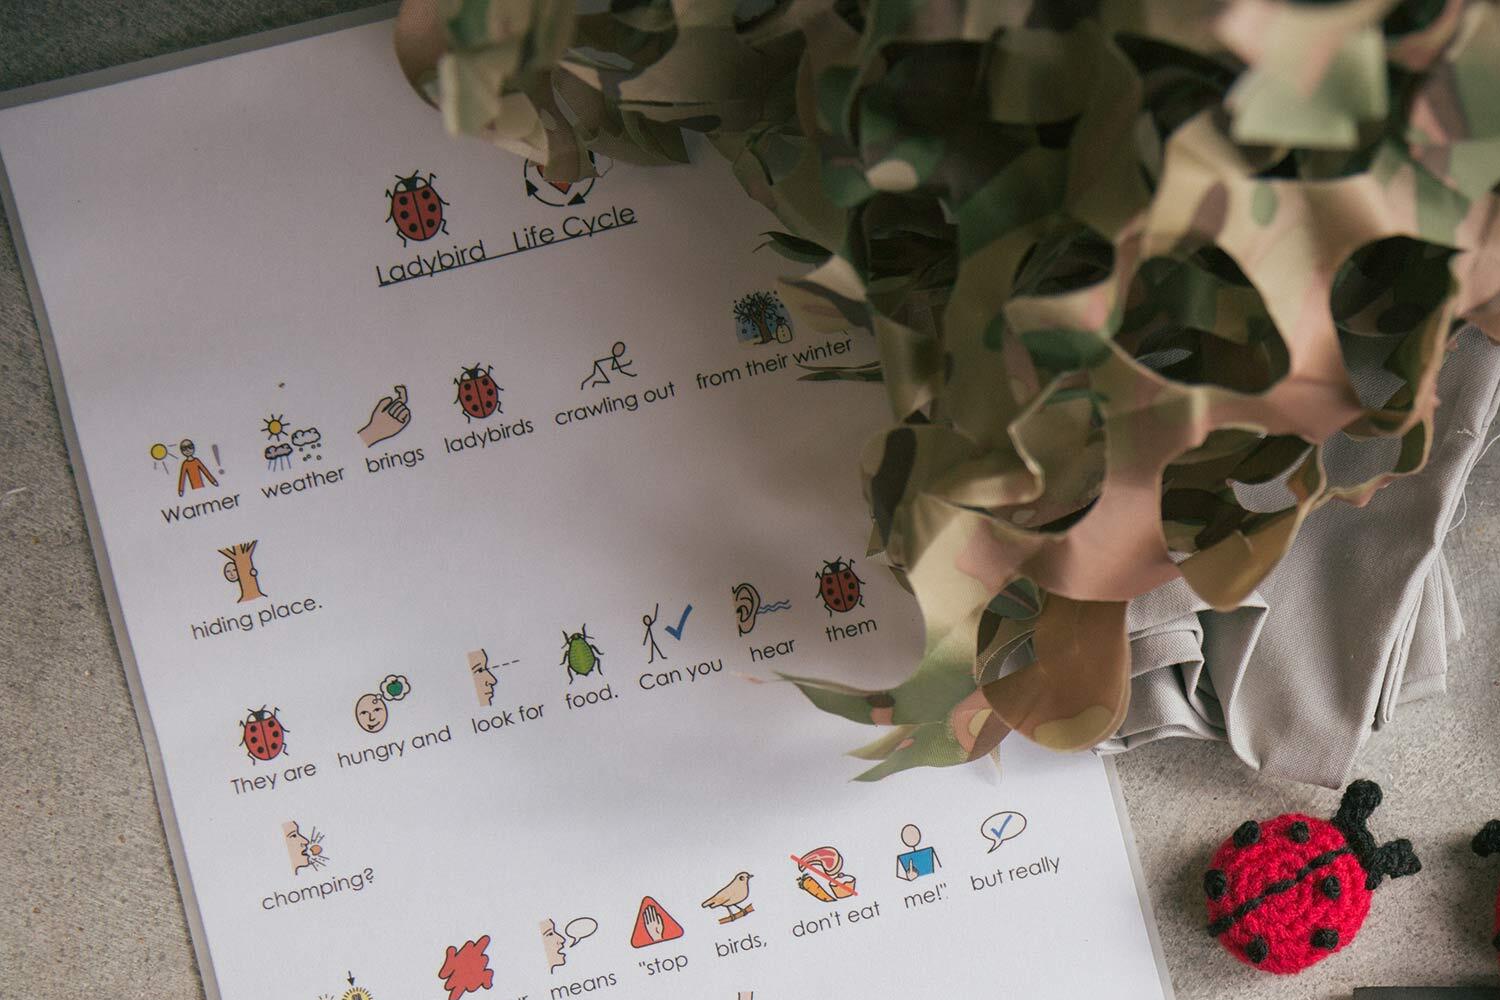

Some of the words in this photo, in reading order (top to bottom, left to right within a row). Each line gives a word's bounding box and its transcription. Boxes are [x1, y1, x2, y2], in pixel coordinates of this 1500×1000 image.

[376, 240, 487, 286] Ladybird
[513, 225, 555, 252] Life
[562, 206, 636, 238] Cycle
[161, 494, 240, 523] Warmer
[261, 468, 344, 498] weather
[365, 448, 425, 473] brings
[444, 419, 534, 453] ladybirds
[555, 394, 638, 425] crawling
[644, 381, 675, 403] out
[696, 368, 741, 389] from
[746, 354, 787, 376] their
[793, 339, 851, 369] winter
[191, 614, 254, 640] hiding
[258, 598, 322, 627] place.
[230, 773, 277, 794] They
[284, 764, 316, 782] are
[337, 740, 405, 768] hungry
[412, 725, 452, 749] and
[471, 710, 515, 734] look
[518, 704, 544, 722] for
[565, 684, 618, 710] food.
[639, 670, 682, 690] Can
[686, 659, 723, 682] you
[749, 639, 795, 662] hear
[825, 620, 877, 642] them
[262, 868, 374, 910] chomping?
[550, 973, 617, 1000] means
[638, 955, 688, 976] "stop
[715, 933, 767, 957] birds,
[792, 911, 841, 937] don't
[848, 901, 880, 923] eat
[970, 869, 1003, 891] but
[1009, 856, 1059, 881] really
